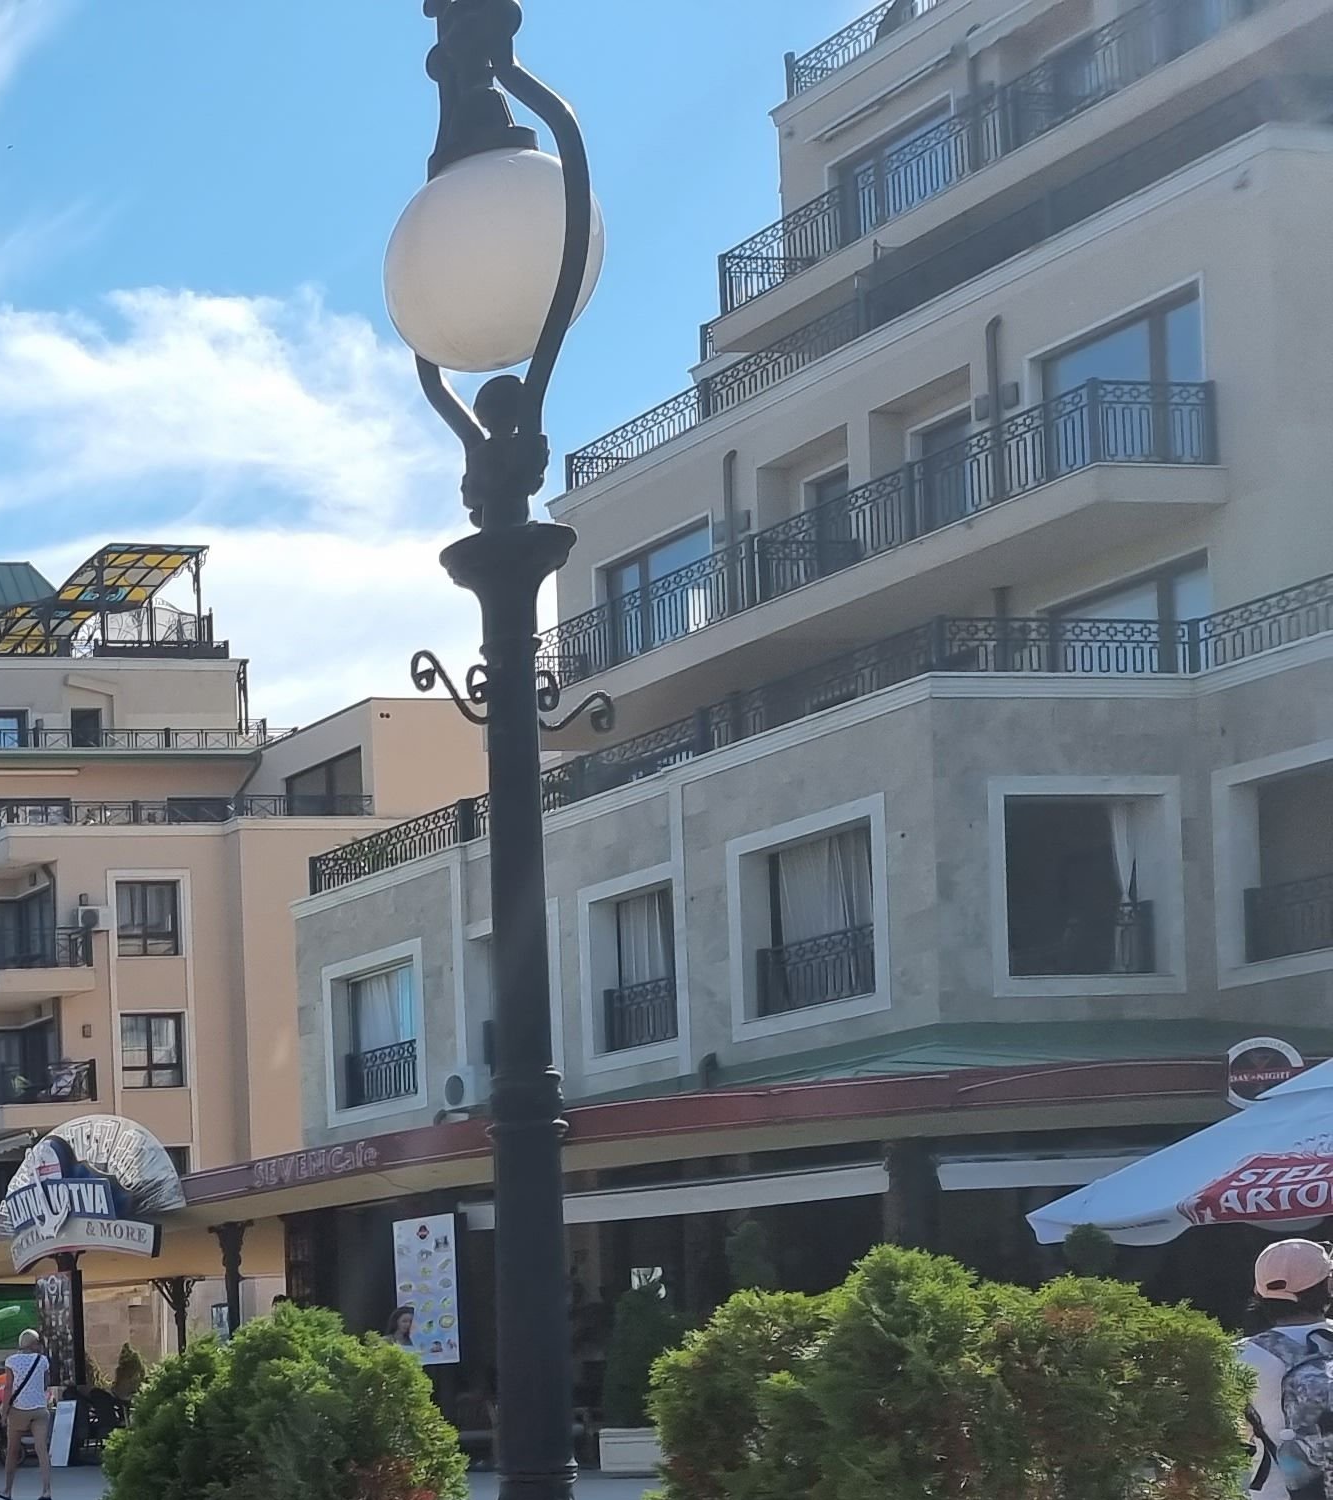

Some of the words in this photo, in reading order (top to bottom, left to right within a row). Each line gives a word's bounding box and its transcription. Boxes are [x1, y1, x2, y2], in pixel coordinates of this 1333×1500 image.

[253, 1149, 326, 1188] SEVEN
[330, 1141, 377, 1173] Cafe
[1229, 1162, 1333, 1186] STEL
[47, 1183, 109, 1215] KOTVA
[1219, 1181, 1333, 1214] ARTO
[99, 1222, 147, 1244] MORE
